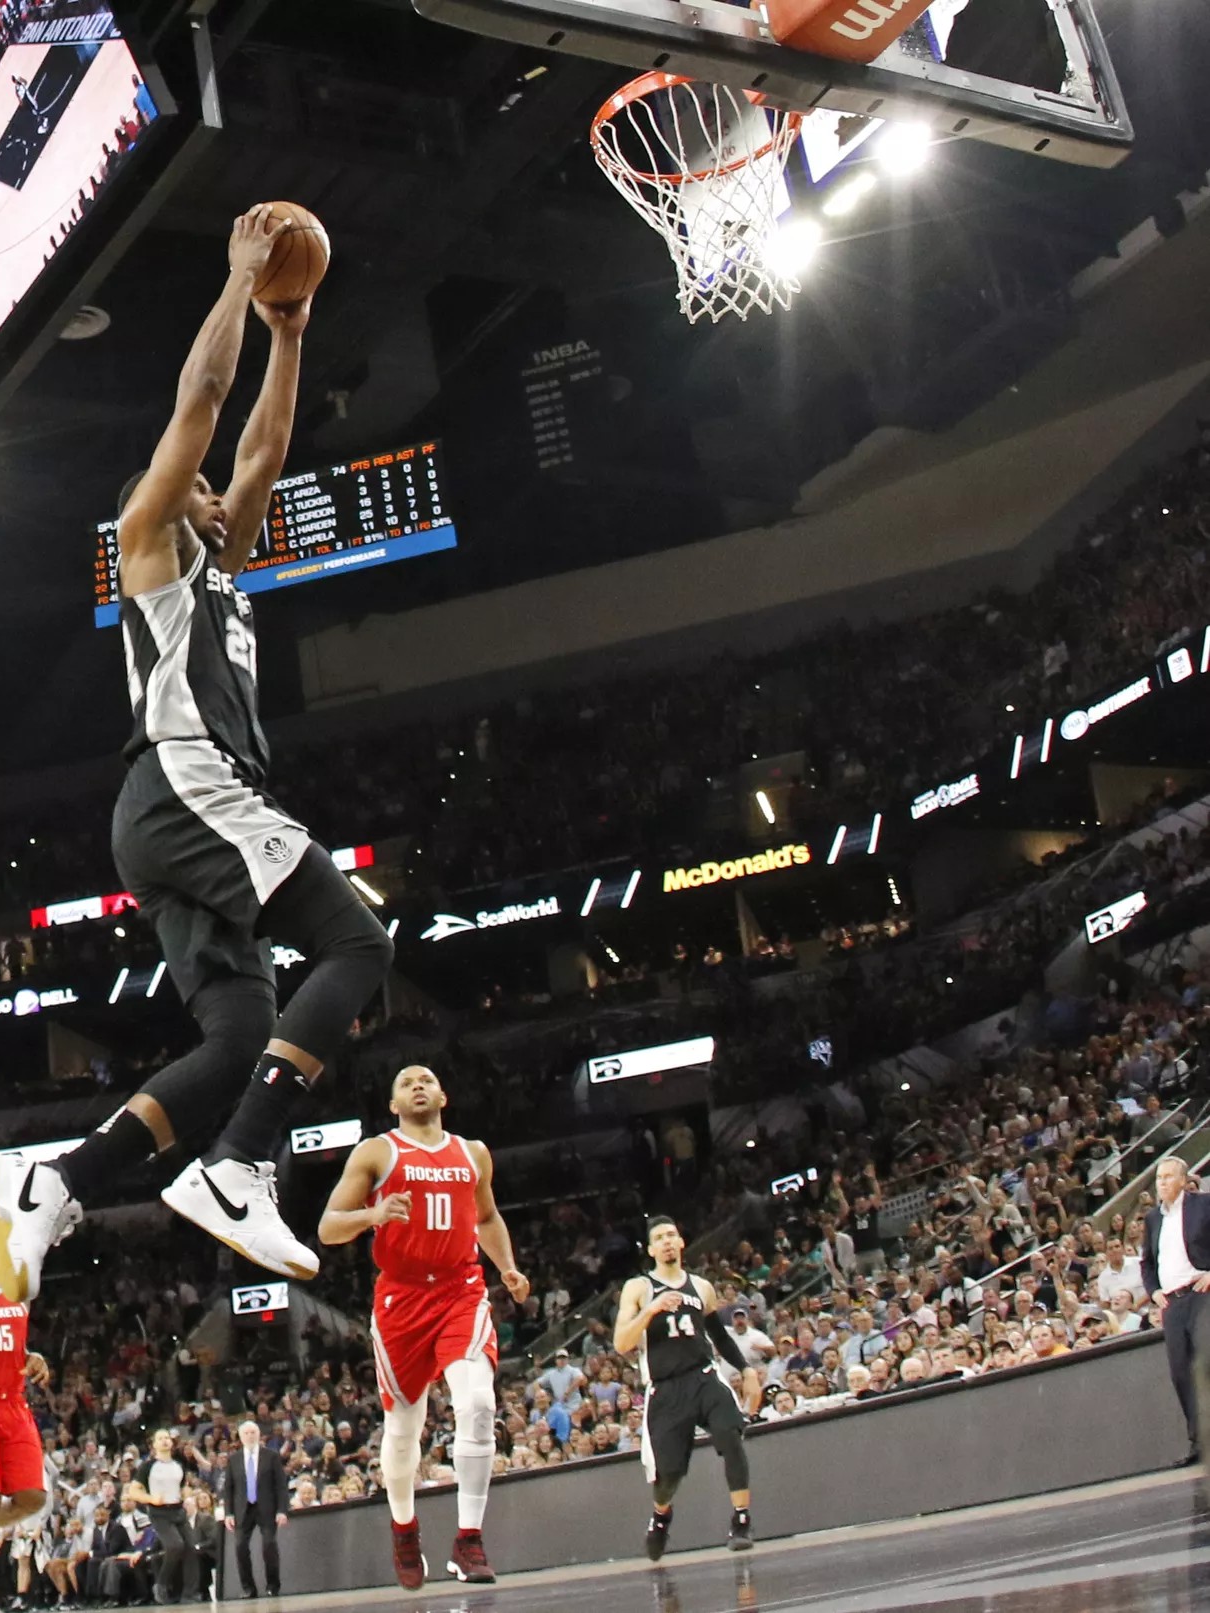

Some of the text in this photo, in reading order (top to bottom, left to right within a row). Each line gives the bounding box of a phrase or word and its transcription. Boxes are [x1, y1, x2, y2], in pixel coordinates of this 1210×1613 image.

[541, 340, 589, 362] NBA
[272, 444, 436, 491] ROCKETS 74 PTS REB AST PF
[293, 486, 321, 499] ARIZA
[358, 474, 366, 483] 4
[381, 469, 389, 478] 3
[403, 463, 411, 473] 0
[427, 458, 434, 466] 1
[295, 495, 332, 510] TUCKER
[359, 486, 367, 496] 3
[382, 481, 390, 490] 3
[406, 475, 413, 484] 1
[427, 470, 436, 479] 0
[296, 506, 336, 523] GORDON
[359, 497, 372, 507] 16
[384, 493, 392, 502] 3
[406, 487, 415, 496] 0
[429, 481, 438, 491] 5
[97, 520, 120, 533] SPU
[297, 518, 337, 534] HARDEN
[359, 509, 373, 520] 25
[385, 504, 394, 514] 3
[408, 499, 416, 508] 7
[431, 493, 440, 502] 4
[299, 531, 336, 546] CAPELA
[362, 521, 374, 531] 11
[385, 515, 399, 525] 10
[409, 511, 418, 520] 0
[432, 505, 441, 515] 0
[247, 560, 269, 571] TEAM
[316, 545, 333, 554] TOL
[336, 541, 343, 551] 2
[352, 537, 363, 546] FT
[419, 521, 430, 530] FG
[431, 516, 452, 528] 34%
[324, 548, 386, 570] PERFORMANCE
[94, 561, 106, 569] 12
[95, 572, 106, 581] 14
[95, 584, 108, 593] 22
[663, 844, 812, 892] McDonald's
[476, 896, 561, 929] SeaWorld
[40, 988, 79, 1007] BELL
[404, 1163, 471, 1183] ROCKETS
[424, 1192, 452, 1231] 10
[666, 1313, 695, 1338] 14
